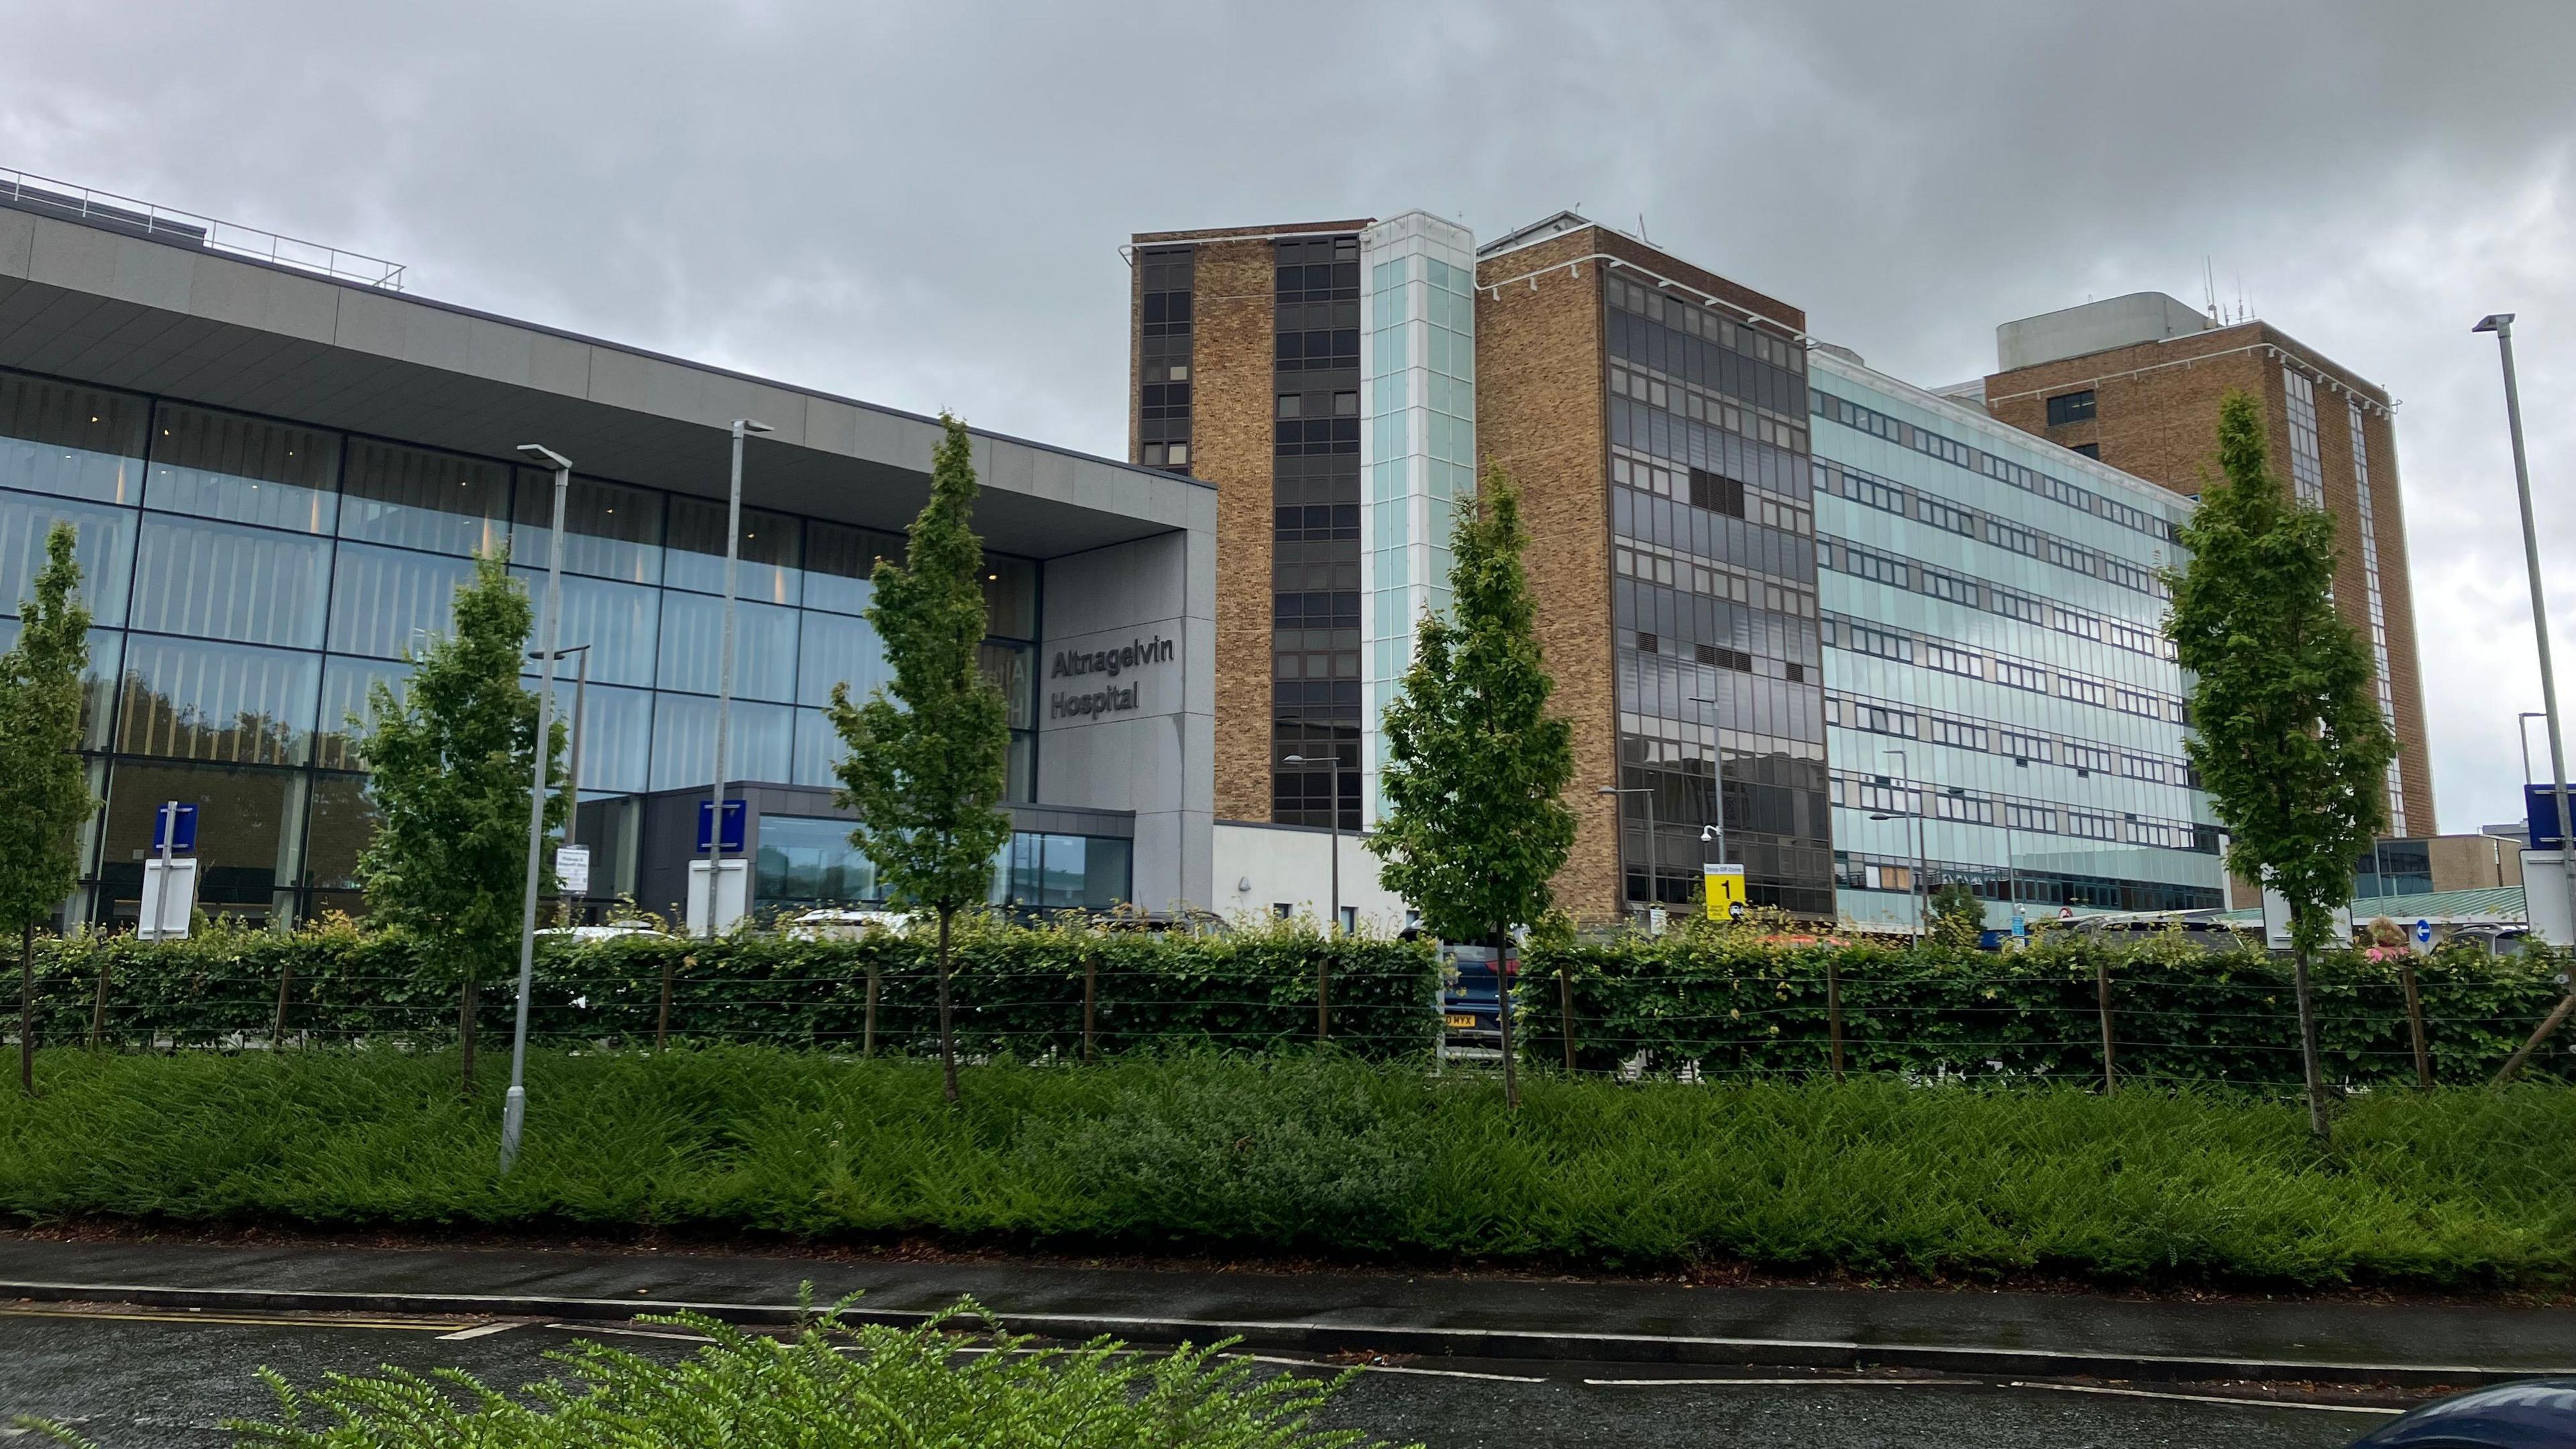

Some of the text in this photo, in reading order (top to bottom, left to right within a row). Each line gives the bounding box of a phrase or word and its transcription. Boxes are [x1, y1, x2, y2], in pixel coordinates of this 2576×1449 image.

[1051, 635, 1174, 679] Altnagelvin
[1051, 681, 1140, 720] Hospital
[1721, 880, 1730, 899] 1
